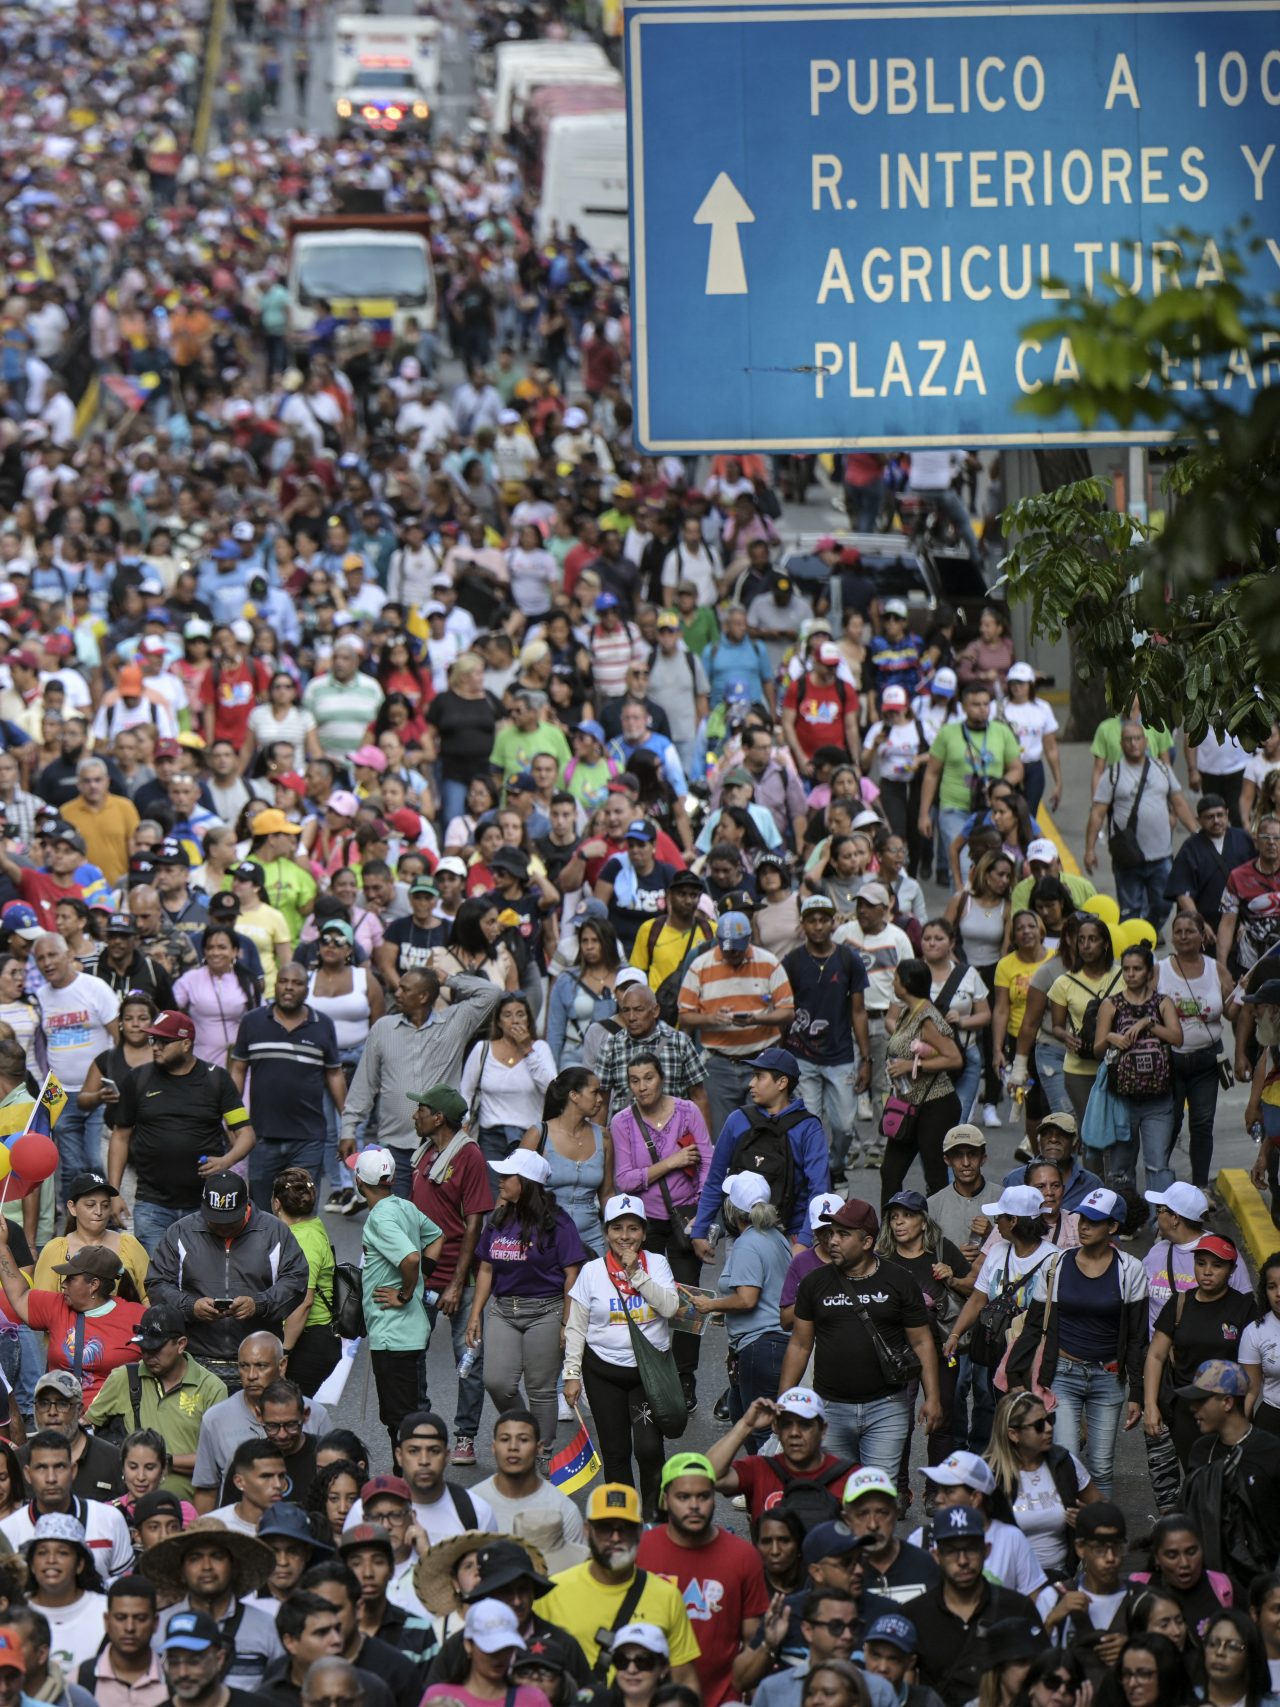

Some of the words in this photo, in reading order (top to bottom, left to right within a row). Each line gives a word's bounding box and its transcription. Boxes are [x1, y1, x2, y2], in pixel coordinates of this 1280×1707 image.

[810, 55, 1045, 116] PUBLICO
[1104, 52, 1141, 110] A
[812, 154, 858, 211] R.
[880, 146, 1209, 209] INTERIORES
[1241, 144, 1276, 201] Y
[817, 241, 1225, 304] AGRICULTURA
[815, 340, 987, 399] PLAZA
